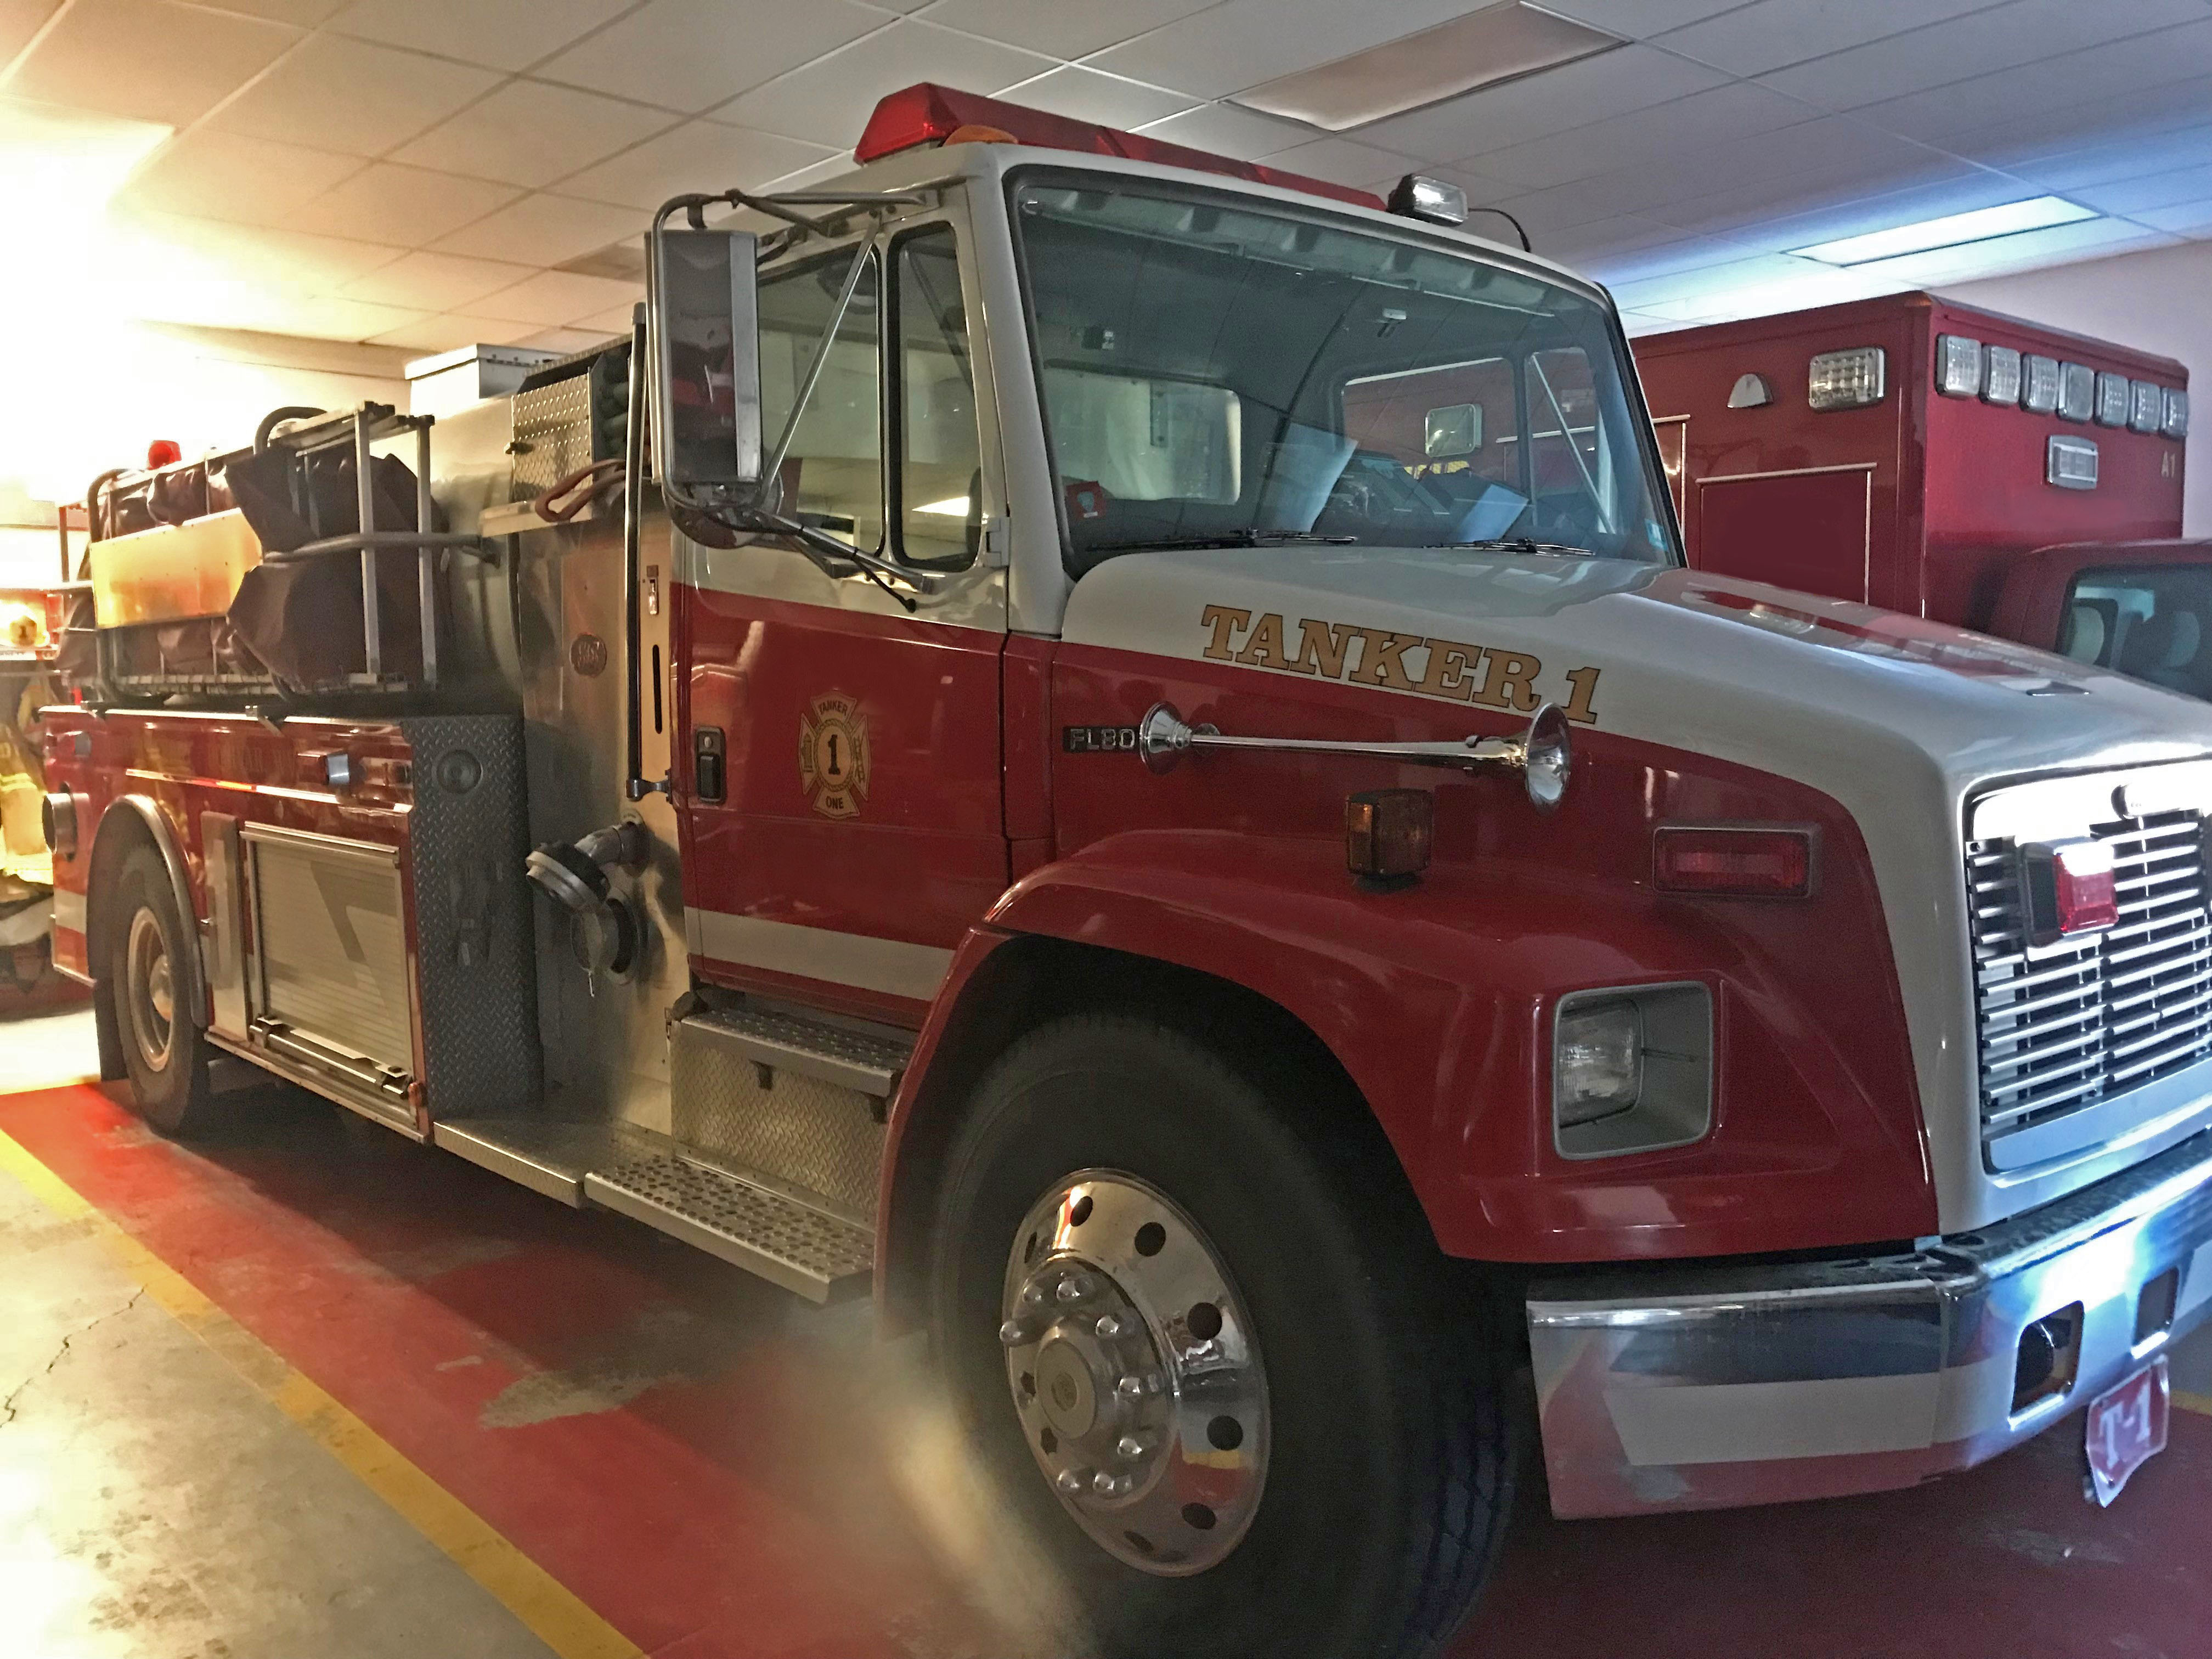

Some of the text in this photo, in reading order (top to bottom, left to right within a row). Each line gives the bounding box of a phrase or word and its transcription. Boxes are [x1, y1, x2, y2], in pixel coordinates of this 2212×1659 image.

[1201, 604, 1601, 725] TANKER 1
[818, 699, 848, 716] TANKER
[827, 733, 841, 775] 1
[1070, 728, 1135, 750] FL80
[825, 795, 844, 810] ONE
[2098, 1380, 2151, 1470] T-1
